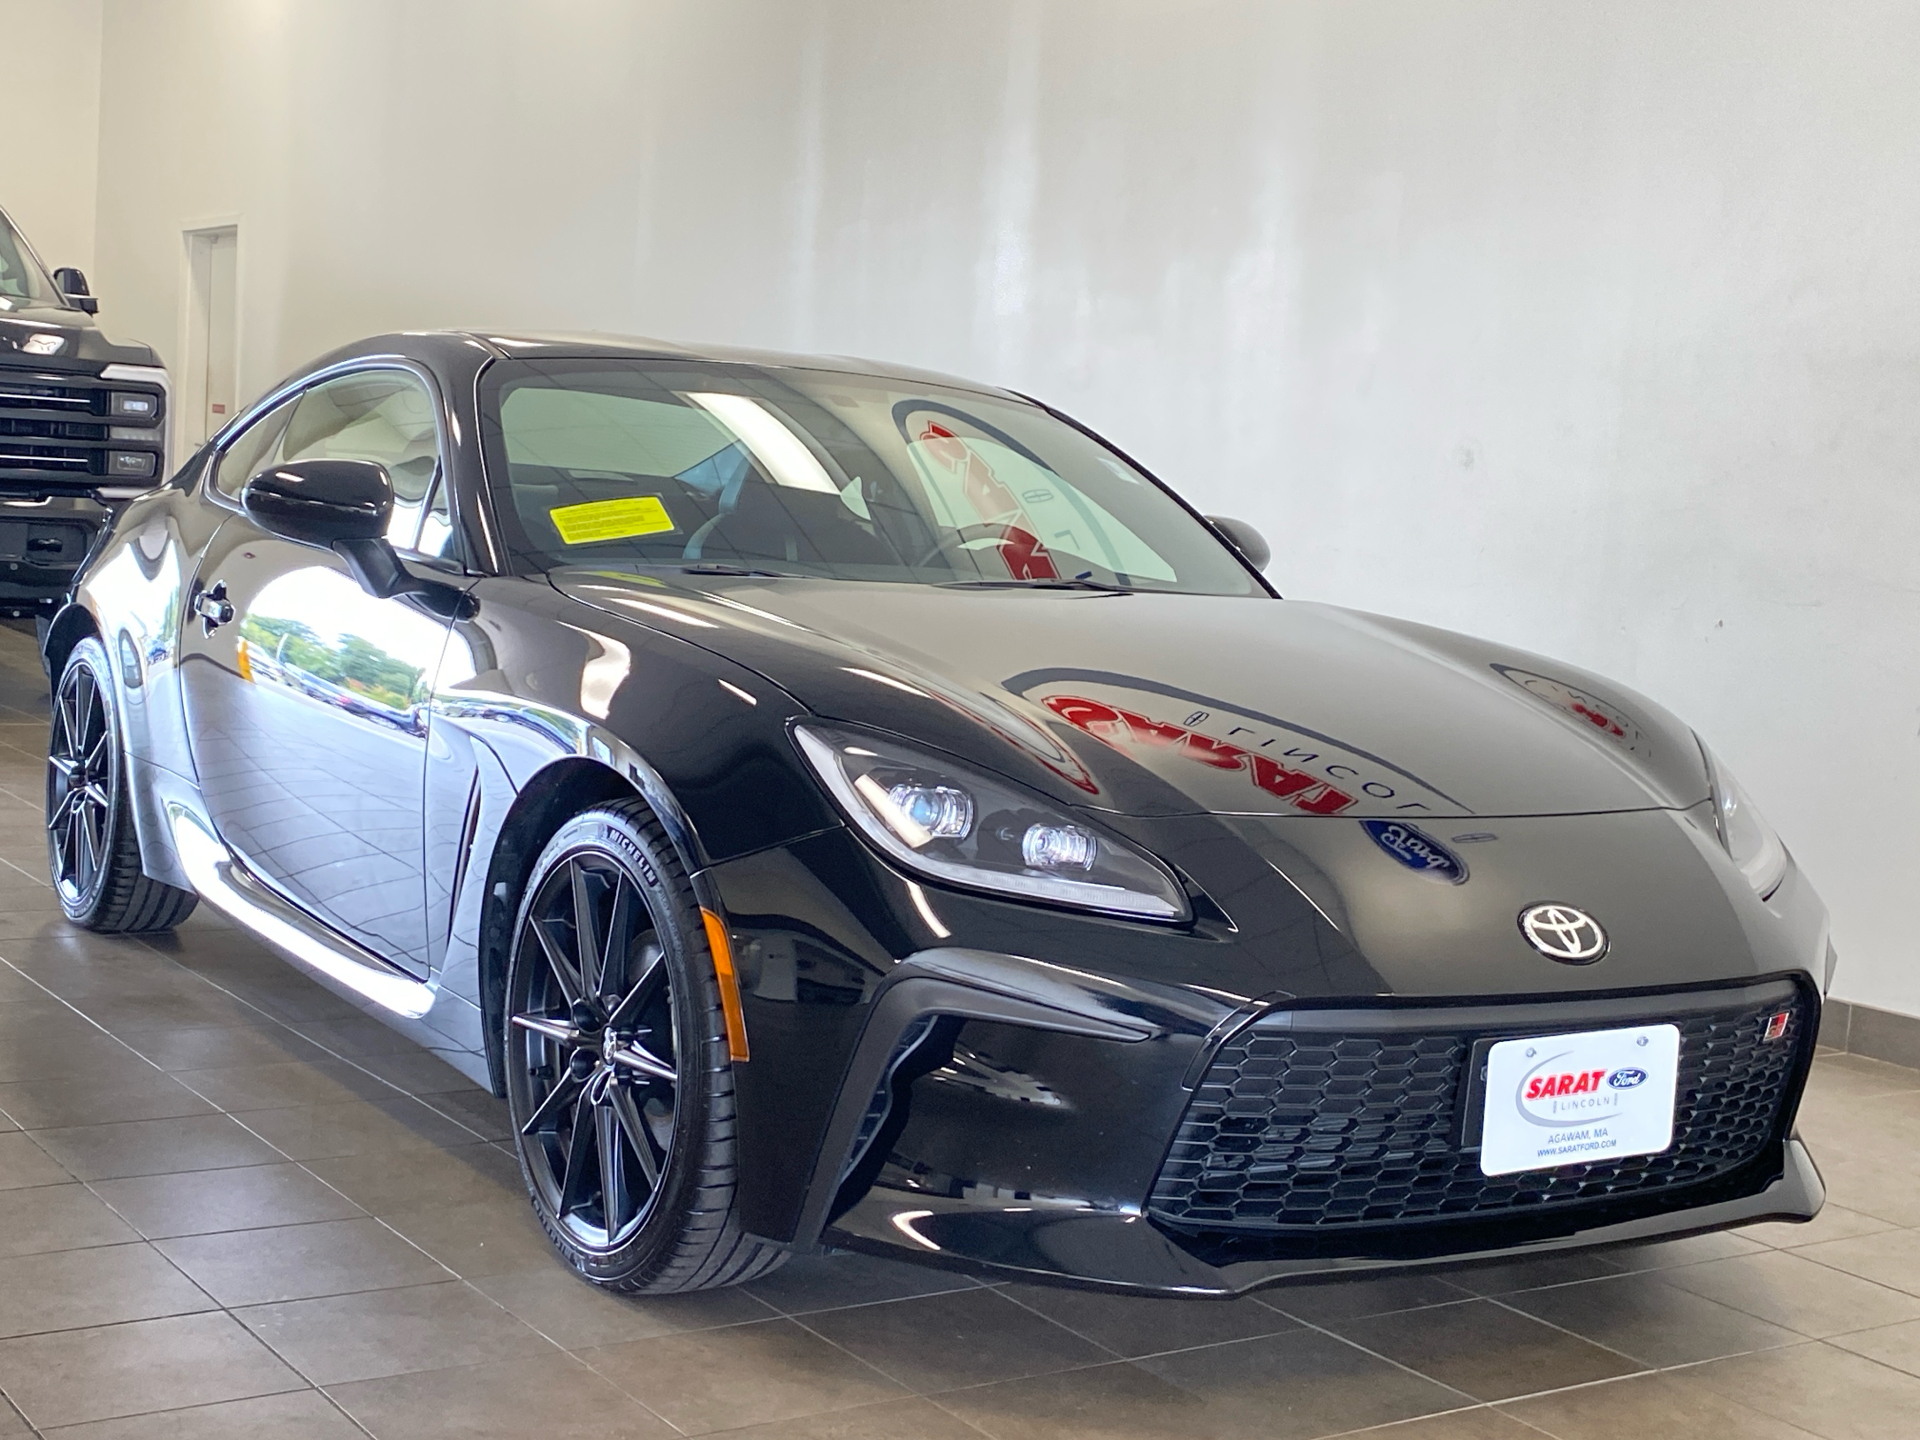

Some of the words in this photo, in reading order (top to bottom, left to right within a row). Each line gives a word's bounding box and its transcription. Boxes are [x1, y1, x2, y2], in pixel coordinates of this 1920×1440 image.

[609, 828, 656, 883] MICHELIN
[1526, 1070, 1606, 1099] SARAT
[1613, 1070, 1642, 1087] Ford
[1561, 1097, 1610, 1110] LINCOLN
[1548, 1129, 1591, 1144] AGAWAM,
[1594, 1128, 1608, 1138] MA
[1537, 1140, 1617, 1156] WWW.SARATFORD.COM
